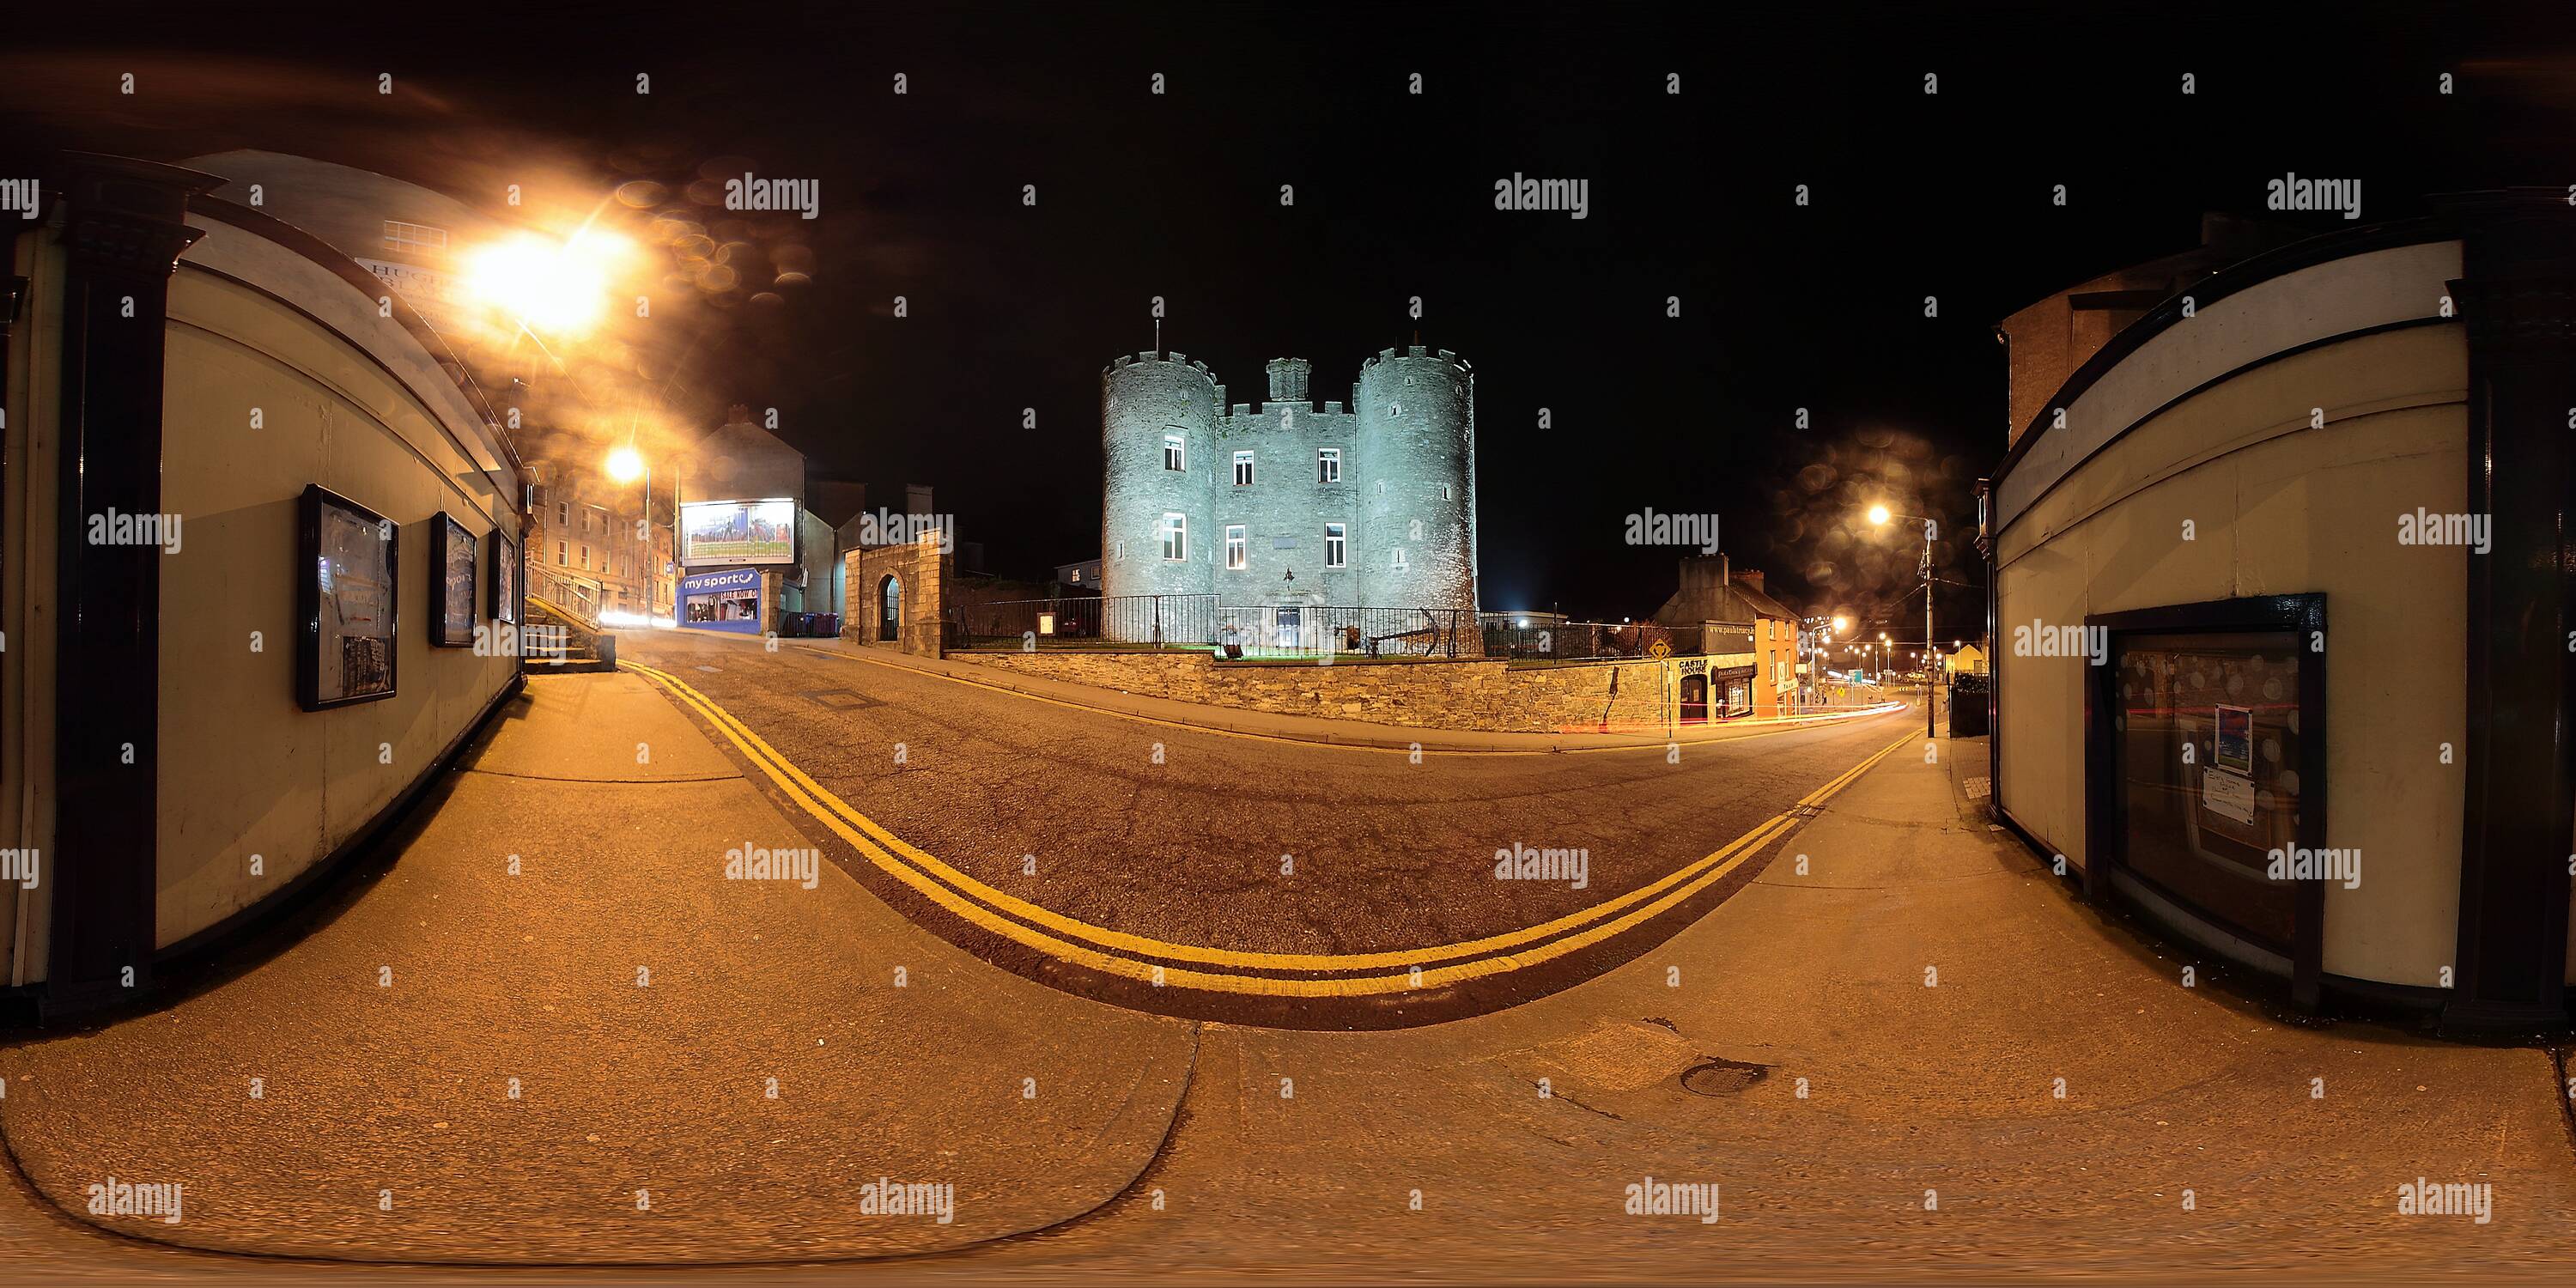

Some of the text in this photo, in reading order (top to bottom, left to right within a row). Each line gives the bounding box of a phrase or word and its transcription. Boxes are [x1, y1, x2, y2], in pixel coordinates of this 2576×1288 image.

[685, 574, 739, 589] my sport
[721, 591, 735, 599] SALE
[737, 590, 749, 598] NOW
[1680, 659, 1708, 668] CASTLE
[1681, 666, 1707, 675] HOUSE
